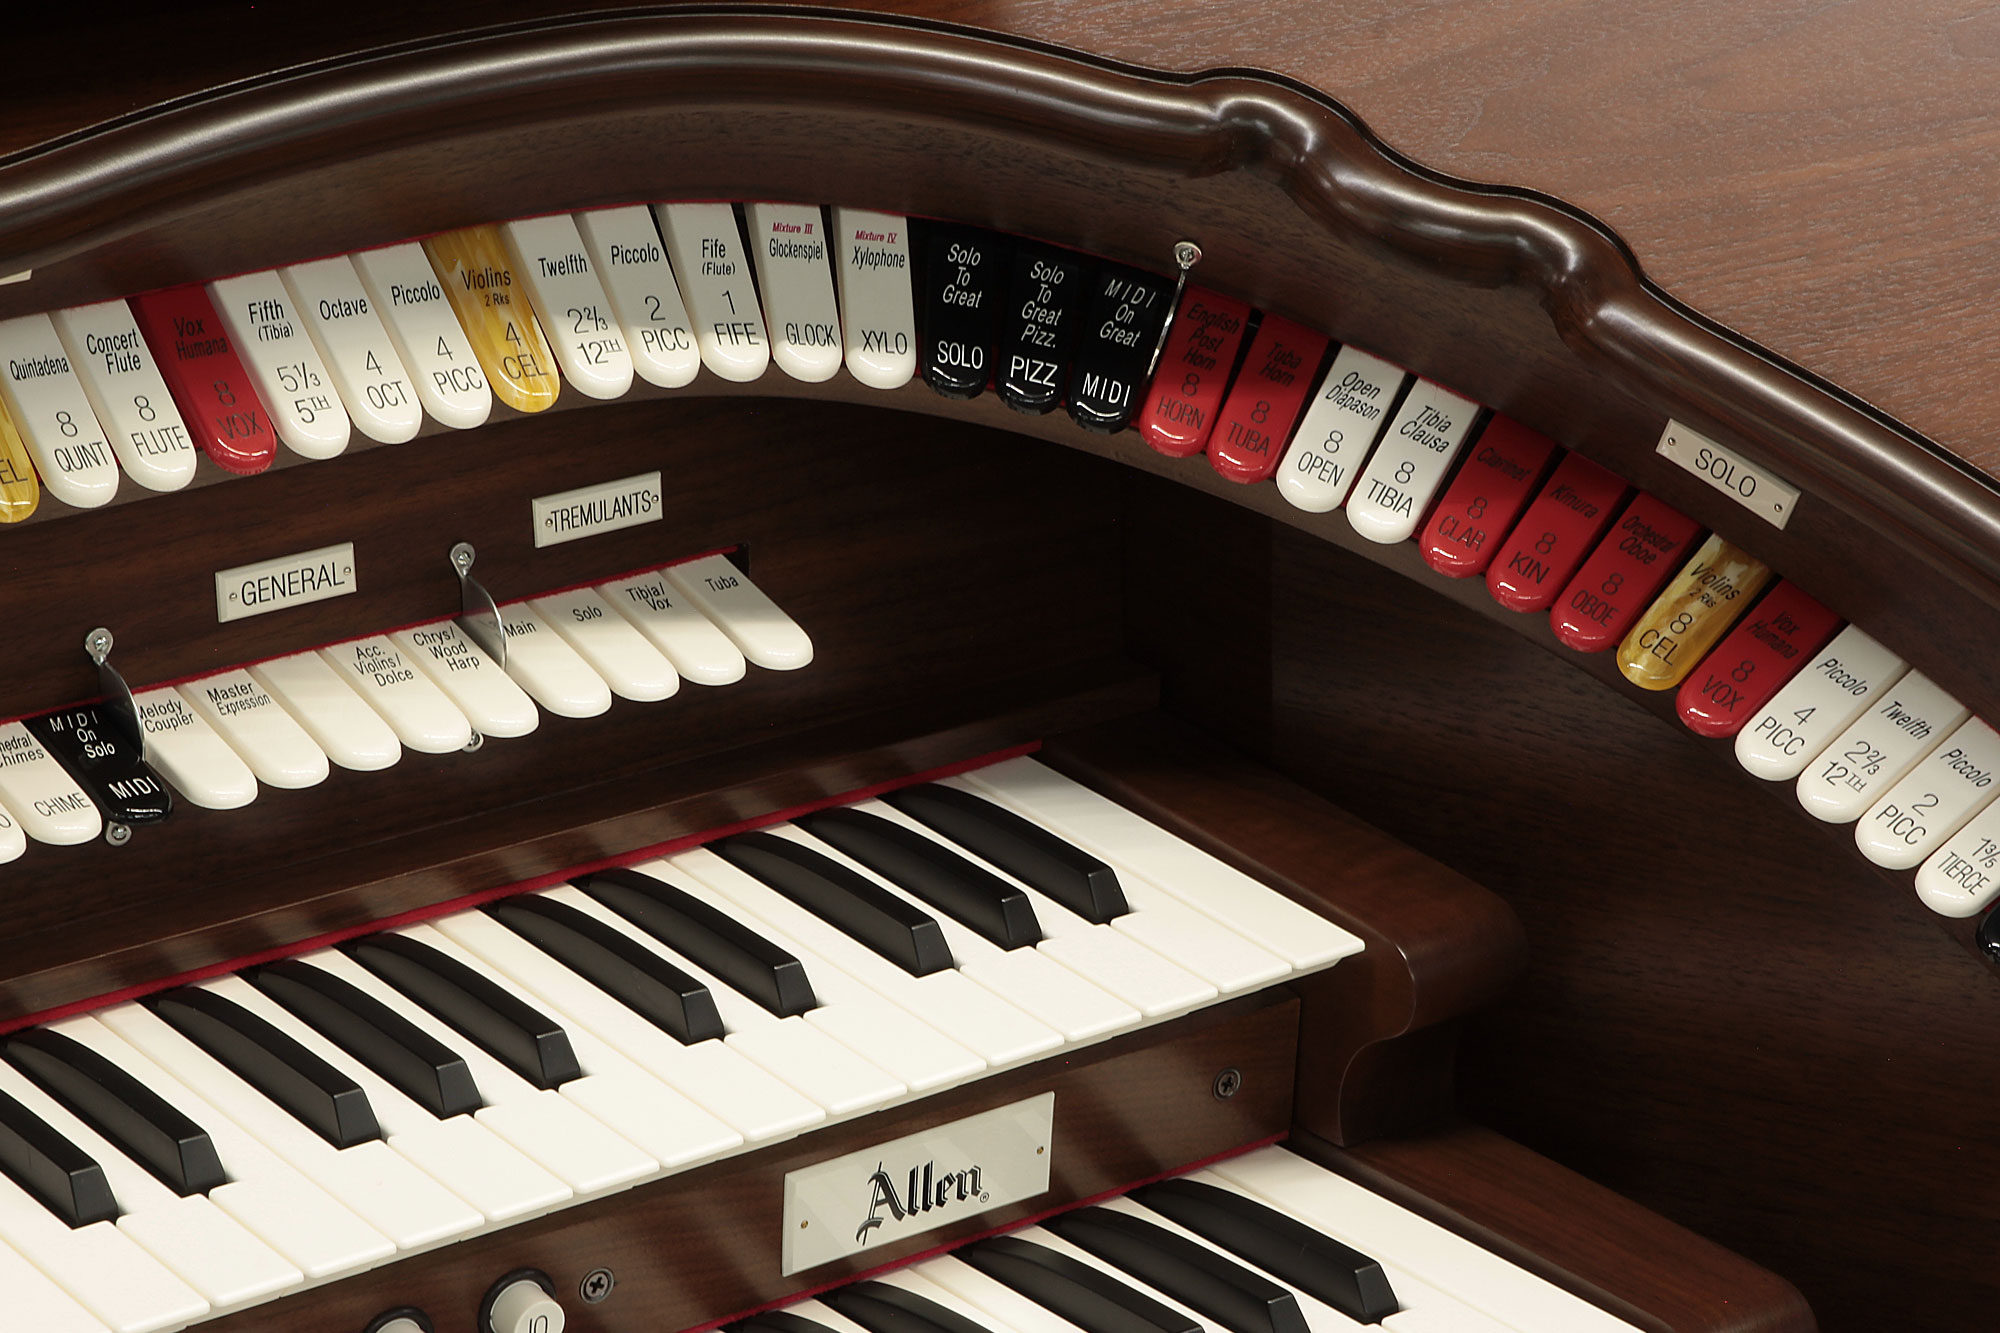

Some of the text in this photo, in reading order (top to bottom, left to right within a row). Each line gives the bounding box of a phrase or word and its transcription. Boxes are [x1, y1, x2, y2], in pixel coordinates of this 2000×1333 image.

[772, 222, 813, 235] Mixture III
[855, 230, 898, 244] Mixture IV
[610, 243, 659, 265] Piccolo
[702, 238, 726, 258] Fife
[769, 238, 823, 263] Glockenspiel
[851, 246, 905, 270] Xylophone
[948, 243, 981, 266] Solo
[538, 253, 588, 278] Twelfth
[702, 261, 736, 275] (Flute)
[956, 266, 970, 286] To
[1030, 261, 1064, 284] Solo
[461, 267, 511, 290] Violins
[391, 281, 440, 306] Piccolo
[484, 293, 510, 307] 2 Rks
[722, 290, 735, 315] 1
[943, 284, 982, 308] Great
[1037, 283, 1051, 304] To
[1105, 279, 1156, 308] MIDI
[248, 299, 284, 324] Fifth
[319, 298, 368, 320] Octave
[645, 295, 666, 321] 2
[1022, 301, 1062, 326] Great
[1115, 304, 1134, 324] On
[1187, 303, 1240, 335] English
[173, 317, 206, 338] Vox
[258, 322, 293, 341] (Tibia)
[505, 321, 521, 346] 4
[641, 327, 690, 351] PICC
[714, 323, 759, 346] FIFE
[786, 323, 837, 347] GLOCK
[1021, 323, 1056, 348] Pizz.
[1100, 321, 1141, 348] Great
[1188, 327, 1224, 353] Post
[86, 328, 139, 355] Concert
[175, 336, 228, 361] Humana
[436, 336, 453, 361] 4
[861, 329, 907, 355] XYLO
[105, 352, 141, 375] Flute
[366, 350, 382, 376] 4
[503, 354, 548, 380] CEL
[937, 340, 983, 369] SOLO
[1183, 347, 1216, 371] Horn
[1266, 343, 1302, 369] Tuba
[9, 356, 69, 381] Quintadena
[433, 366, 482, 395] PICC
[1010, 355, 1058, 387] PIZZ
[1259, 361, 1295, 387] Horn
[213, 380, 236, 407] 8
[366, 381, 408, 409] OCT
[1082, 373, 1130, 407] MIDI
[1182, 373, 1200, 397] 8
[1342, 371, 1380, 400] Open
[134, 395, 156, 422] 8
[1156, 397, 1206, 430] HORN
[1250, 400, 1270, 424] 8
[1325, 385, 1380, 421] Diapason
[55, 411, 78, 437] 8
[216, 411, 264, 440] VOX
[1415, 405, 1452, 433] Tibia
[131, 426, 189, 457] FLUTE
[1227, 421, 1270, 456] TUBA
[1323, 430, 1343, 454] 8
[1400, 420, 1449, 454] Clausa
[54, 442, 110, 473] QUINT
[1297, 451, 1345, 487] OPEN
[1477, 447, 1532, 482] Clarinet
[1395, 461, 1415, 484] 8
[1695, 448, 1756, 498] SOLO
[1367, 478, 1413, 519] TIBIA
[1467, 496, 1488, 520] 8
[1550, 484, 1599, 520] Kinura
[551, 490, 652, 533] TREMULANTS
[1438, 515, 1486, 552] CLAR
[1535, 532, 1557, 554] 8
[1622, 516, 1680, 554] Orchestral
[1619, 536, 1657, 565] Oboe
[1508, 551, 1550, 584] KIN
[241, 562, 345, 606] GENERAL
[625, 582, 665, 603] Tibia/
[705, 575, 739, 592] Tuba
[1602, 573, 1624, 595] 8
[1690, 562, 1741, 601] Violins
[645, 597, 673, 612] Vox
[1571, 590, 1619, 627] OBOE
[1689, 588, 1717, 609] 2 Rks
[572, 605, 602, 622] Solo
[1670, 612, 1692, 634] 8
[1771, 611, 1800, 636] Vox
[412, 626, 455, 649] Chrys/
[503, 621, 536, 638] Main
[1746, 620, 1799, 660] Humana
[356, 645, 386, 660] Acc.
[428, 641, 467, 660] Wood
[1639, 629, 1679, 666] CEL
[353, 653, 401, 676] Violins/
[447, 654, 480, 671] Harp
[1732, 660, 1755, 683] 8
[373, 668, 414, 687] Dolce
[1816, 658, 1868, 696] Piccolo
[206, 681, 255, 703] Master
[216, 692, 271, 717] Expression
[1702, 675, 1746, 712] VOX
[50, 710, 98, 732] MIDI
[145, 713, 193, 733] Coupler
[1793, 707, 1817, 726] 4
[1880, 701, 1933, 740] Twelfth
[76, 728, 97, 743] On
[1754, 716, 1805, 756] PICC
[0, 748, 44, 768] himes
[85, 741, 115, 759] Solo
[1940, 748, 1992, 788] Piccolo
[108, 776, 160, 800] MIDI
[34, 792, 91, 817] CHIME
[1912, 794, 1939, 816] 2
[1875, 804, 1927, 846] PICC
[1937, 851, 1990, 896] TIERCE
[856, 1160, 982, 1246] Allen
